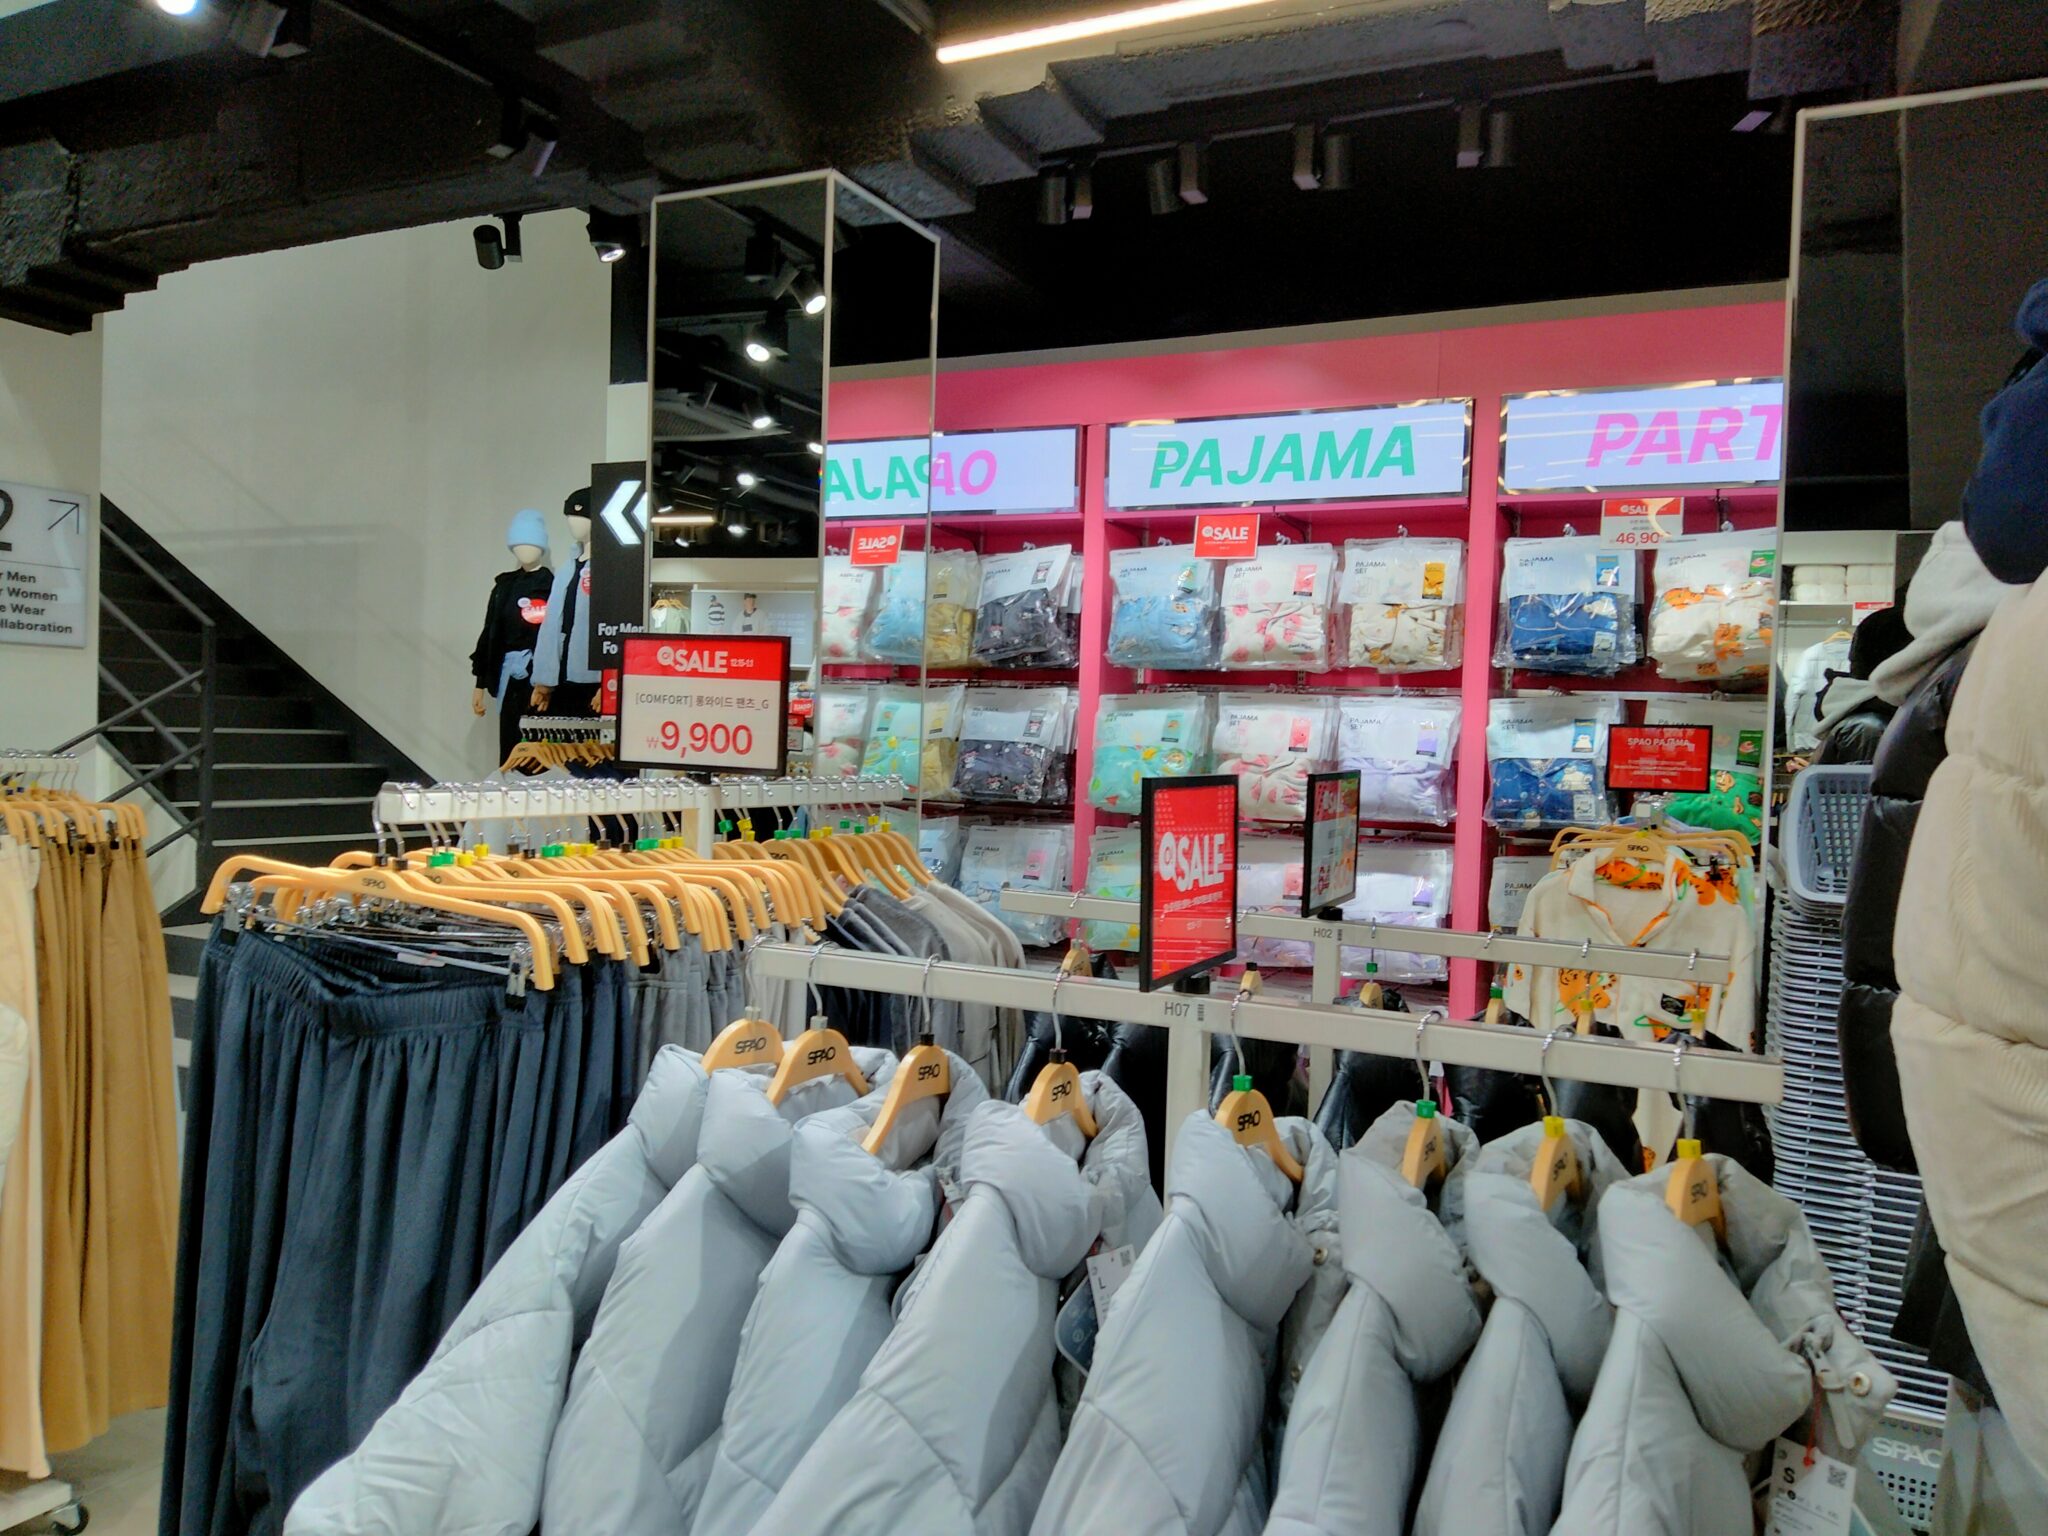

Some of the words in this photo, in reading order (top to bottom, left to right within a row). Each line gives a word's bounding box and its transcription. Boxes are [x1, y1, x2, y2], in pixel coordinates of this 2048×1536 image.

[1150, 426, 1415, 489] PAJAMA
[7, 571, 36, 583] Men
[7, 587, 58, 601] Women
[11, 603, 45, 616] Wear
[598, 623, 618, 636] For
[635, 692, 693, 708] [COMFORT]
[1628, 737, 1652, 746] SPAO
[1627, 844, 1649, 852] SPAO
[1313, 927, 1333, 939] H02
[1164, 1002, 1190, 1017] H07
[734, 1036, 767, 1055] SPAO
[807, 1046, 836, 1066] SPAO
[918, 1063, 941, 1081] SPAO
[1052, 1080, 1072, 1102] SPAO
[1237, 1109, 1261, 1132] SPAO
[1783, 1467, 1795, 1484] S
